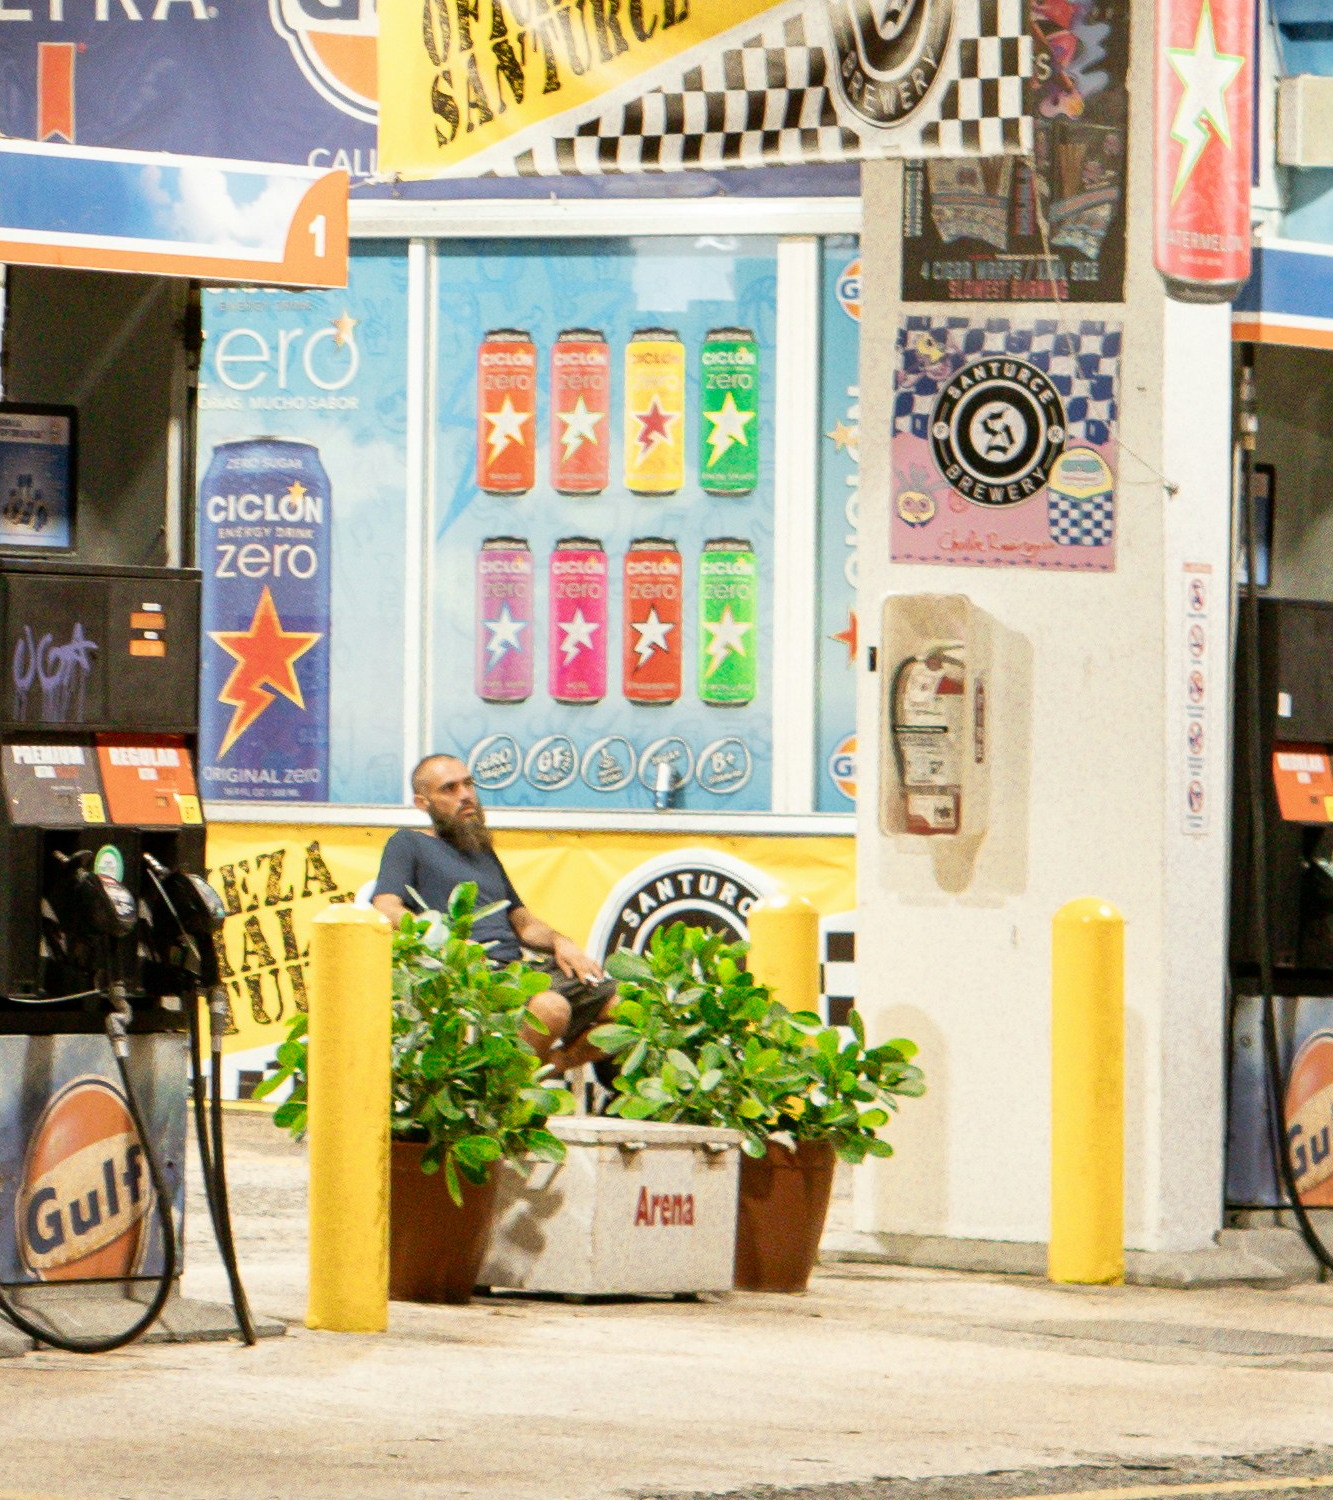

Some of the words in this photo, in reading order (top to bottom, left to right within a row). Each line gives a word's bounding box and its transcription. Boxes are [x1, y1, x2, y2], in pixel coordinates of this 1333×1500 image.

[308, 214, 326, 257] 1
[201, 327, 360, 391] ero
[947, 361, 1056, 406] SANTURCE
[944, 463, 1050, 502] BREWERY
[215, 543, 318, 580] zero
[12, 745, 86, 766] PREMIUM
[108, 746, 181, 768] REGULAR
[202, 765, 281, 784] ORIGINAL
[621, 873, 759, 929] SANTURC
[26, 1142, 145, 1255] Gulf
[633, 1185, 695, 1227] Arena
